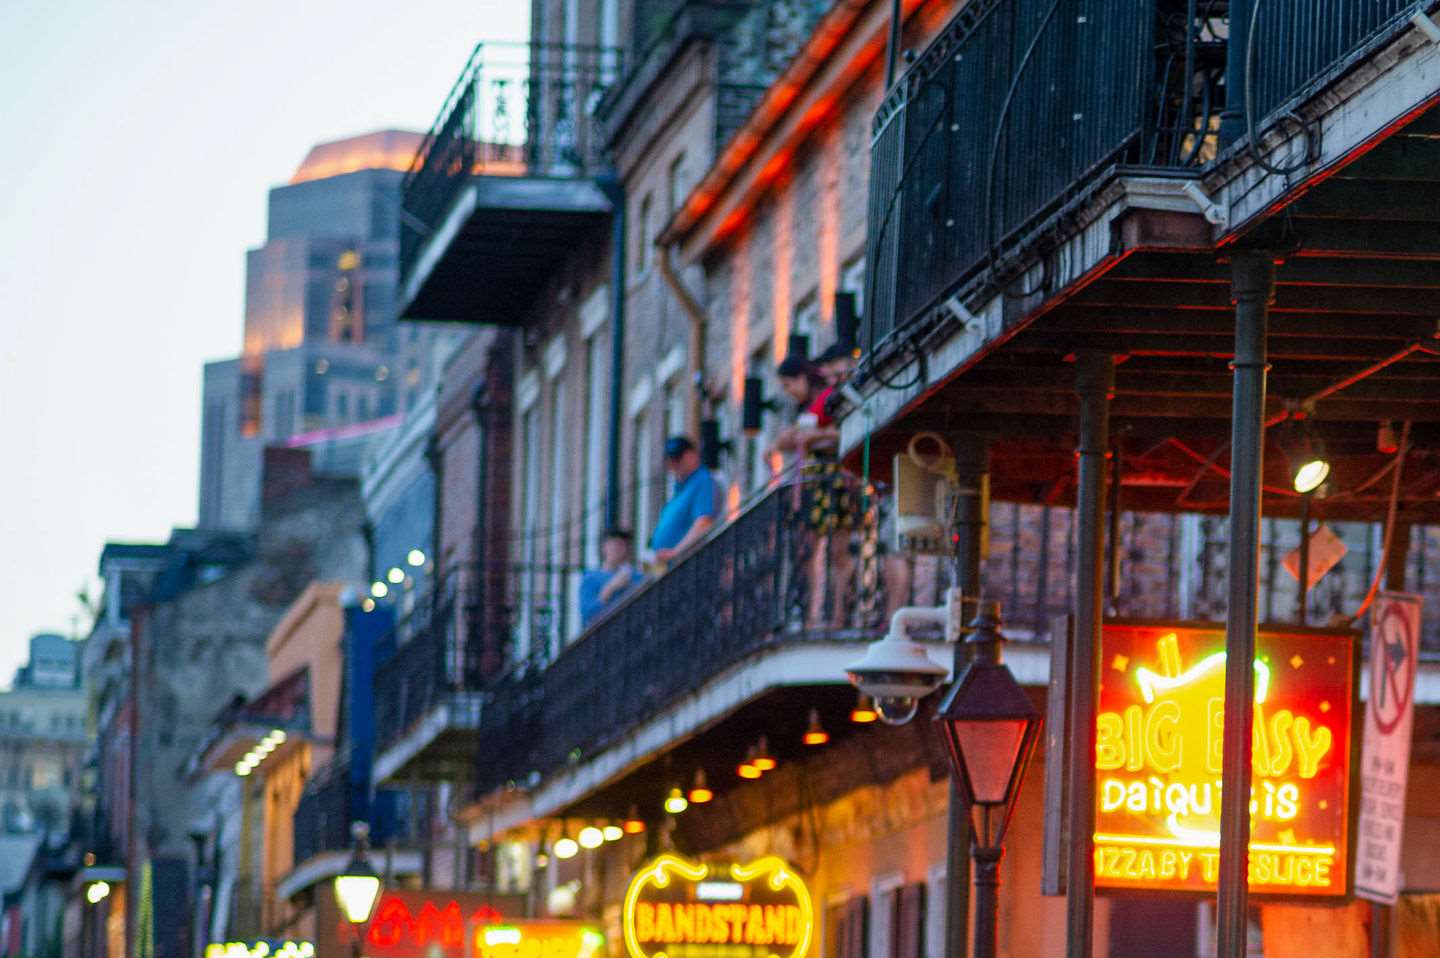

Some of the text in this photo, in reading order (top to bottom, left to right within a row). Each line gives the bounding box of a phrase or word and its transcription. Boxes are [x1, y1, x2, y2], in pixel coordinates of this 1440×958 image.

[1096, 700, 1183, 774] BIG
[1094, 847, 1159, 879] IZZA
[635, 901, 803, 945] BANDSTAND
